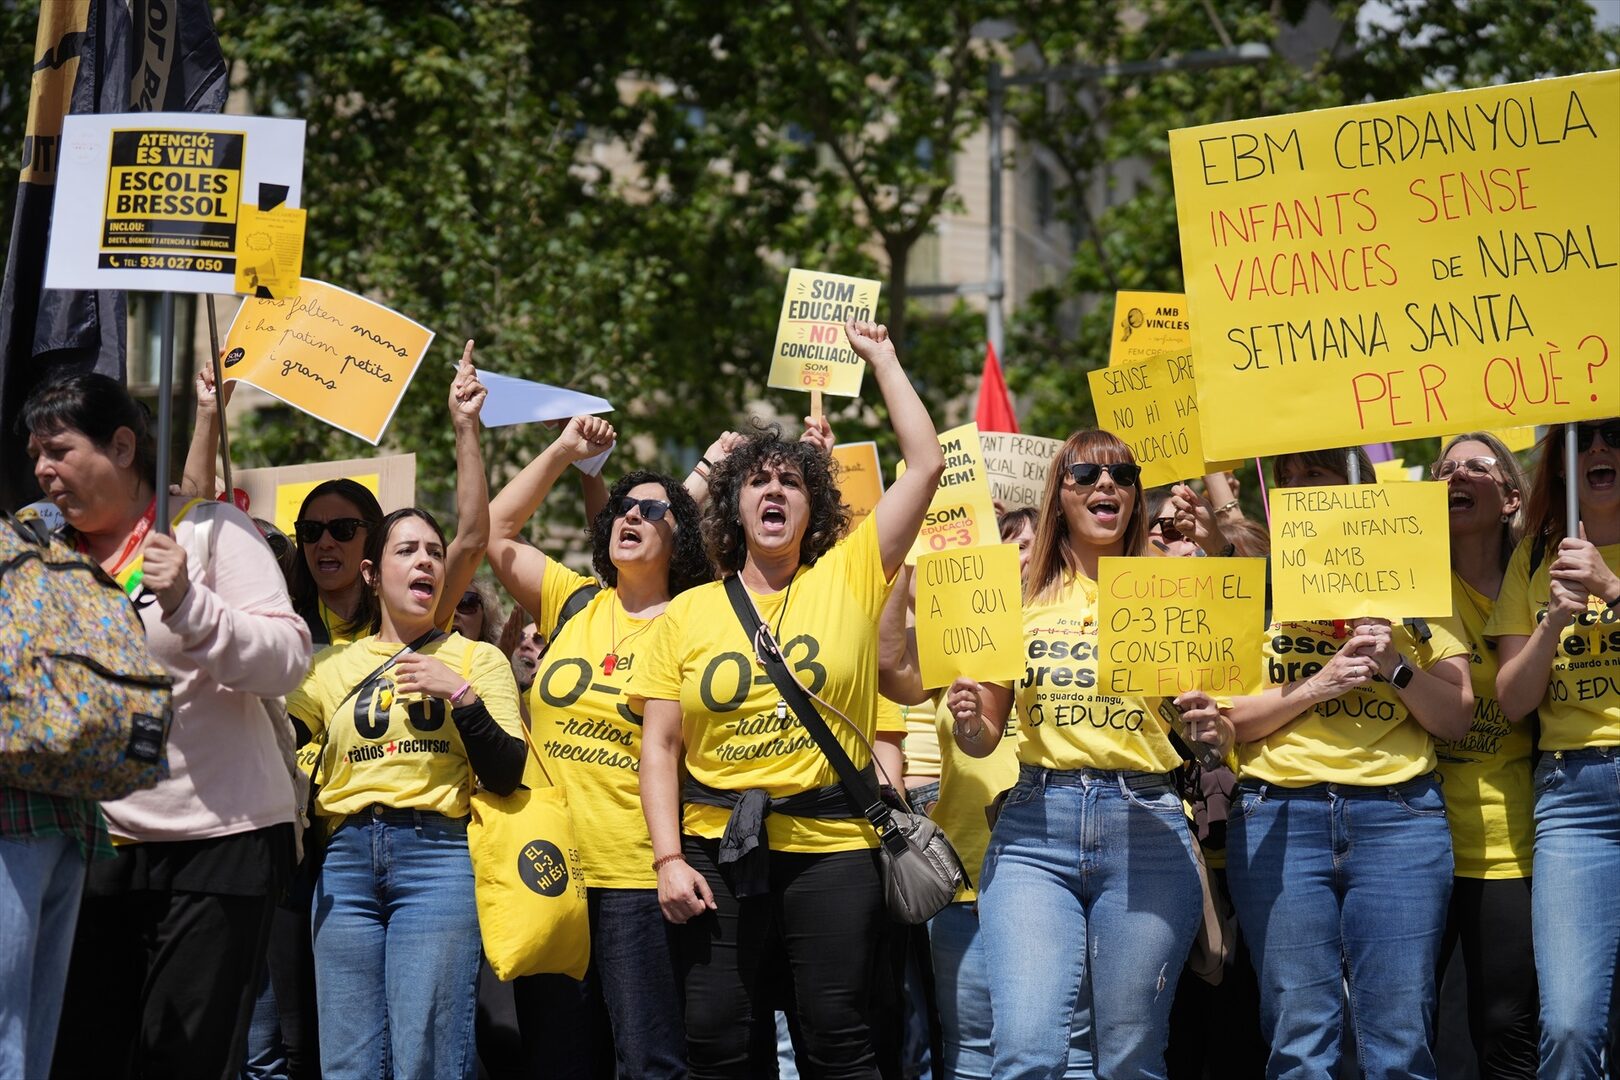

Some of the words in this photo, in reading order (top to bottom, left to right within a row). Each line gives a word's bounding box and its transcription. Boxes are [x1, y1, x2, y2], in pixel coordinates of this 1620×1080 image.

[138, 132, 215, 148] ATENCIÓ:
[1199, 129, 1304, 185] EBM
[1334, 90, 1598, 169] CERDANYOLA
[136, 147, 162, 164] ES
[167, 147, 214, 166] VEN
[120, 171, 228, 194] ESCOLES
[116, 194, 228, 217] BRESSOL
[1210, 188, 1378, 247] INFANTS
[1409, 167, 1537, 223] SENSE
[109, 222, 145, 232] INCLOU:
[129, 236, 155, 245] DIGNITAT
[159, 236, 185, 246] ATENCIÓ
[123, 258, 138, 267] TEL:
[140, 256, 164, 268] 934
[167, 257, 193, 270] 027
[195, 259, 223, 271] 050
[1214, 243, 1398, 301] VACANCES
[1432, 255, 1464, 280] DE
[1477, 224, 1619, 279] NADAL
[810, 279, 855, 303] SOM
[788, 300, 871, 323] EDUCACIÓ
[1155, 307, 1179, 317] AMB
[286, 297, 343, 326] falten
[351, 324, 408, 357] mans
[809, 325, 839, 345] NO
[1146, 319, 1190, 330] VINCLES
[1227, 311, 1390, 371] SETMANA
[1405, 293, 1534, 352] SANTA
[256, 318, 276, 332] ho
[279, 328, 338, 356] patim
[340, 355, 392, 382] petits
[1128, 348, 1145, 356] FEM
[281, 359, 336, 390] grans
[804, 362, 829, 372] SOM
[1103, 365, 1152, 395] SENSE
[1167, 355, 1195, 384] DRE
[802, 375, 826, 386] 0-3
[1351, 363, 1448, 430] PER
[1113, 407, 1134, 430] NO
[1174, 395, 1199, 418] HA
[939, 439, 962, 455] OM
[944, 453, 976, 469] ERIA,
[1022, 461, 1049, 481] DEIX
[937, 468, 976, 489] UEM!
[1281, 488, 1390, 512] TREBALLEM
[925, 506, 967, 526] SOM
[921, 519, 973, 536] EDUCACIÓ
[1281, 520, 1317, 539] AMB
[1343, 516, 1424, 537] INFANTS,
[929, 529, 972, 551] 0-3
[1281, 549, 1306, 568] NO
[1324, 547, 1364, 567] AMB
[926, 555, 985, 587] CUIDEU
[1301, 570, 1401, 594] MIRACLES
[1222, 574, 1252, 600] EL
[930, 594, 943, 618] A
[972, 588, 1007, 615] QUI
[1110, 607, 1157, 634] 0-3
[1164, 607, 1211, 635] PER
[943, 626, 997, 656] CUIDA
[1569, 660, 1602, 672] guardo
[1111, 668, 1144, 694] EL
[1156, 666, 1247, 694] FUTUR
[1036, 693, 1047, 701] no
[1050, 692, 1084, 702] guardo
[1095, 694, 1125, 706] ningú,
[1054, 704, 1145, 732] EDUCO.
[525, 846, 543, 861] EL
[533, 854, 553, 873] 0-3
[537, 875, 553, 890] HI
